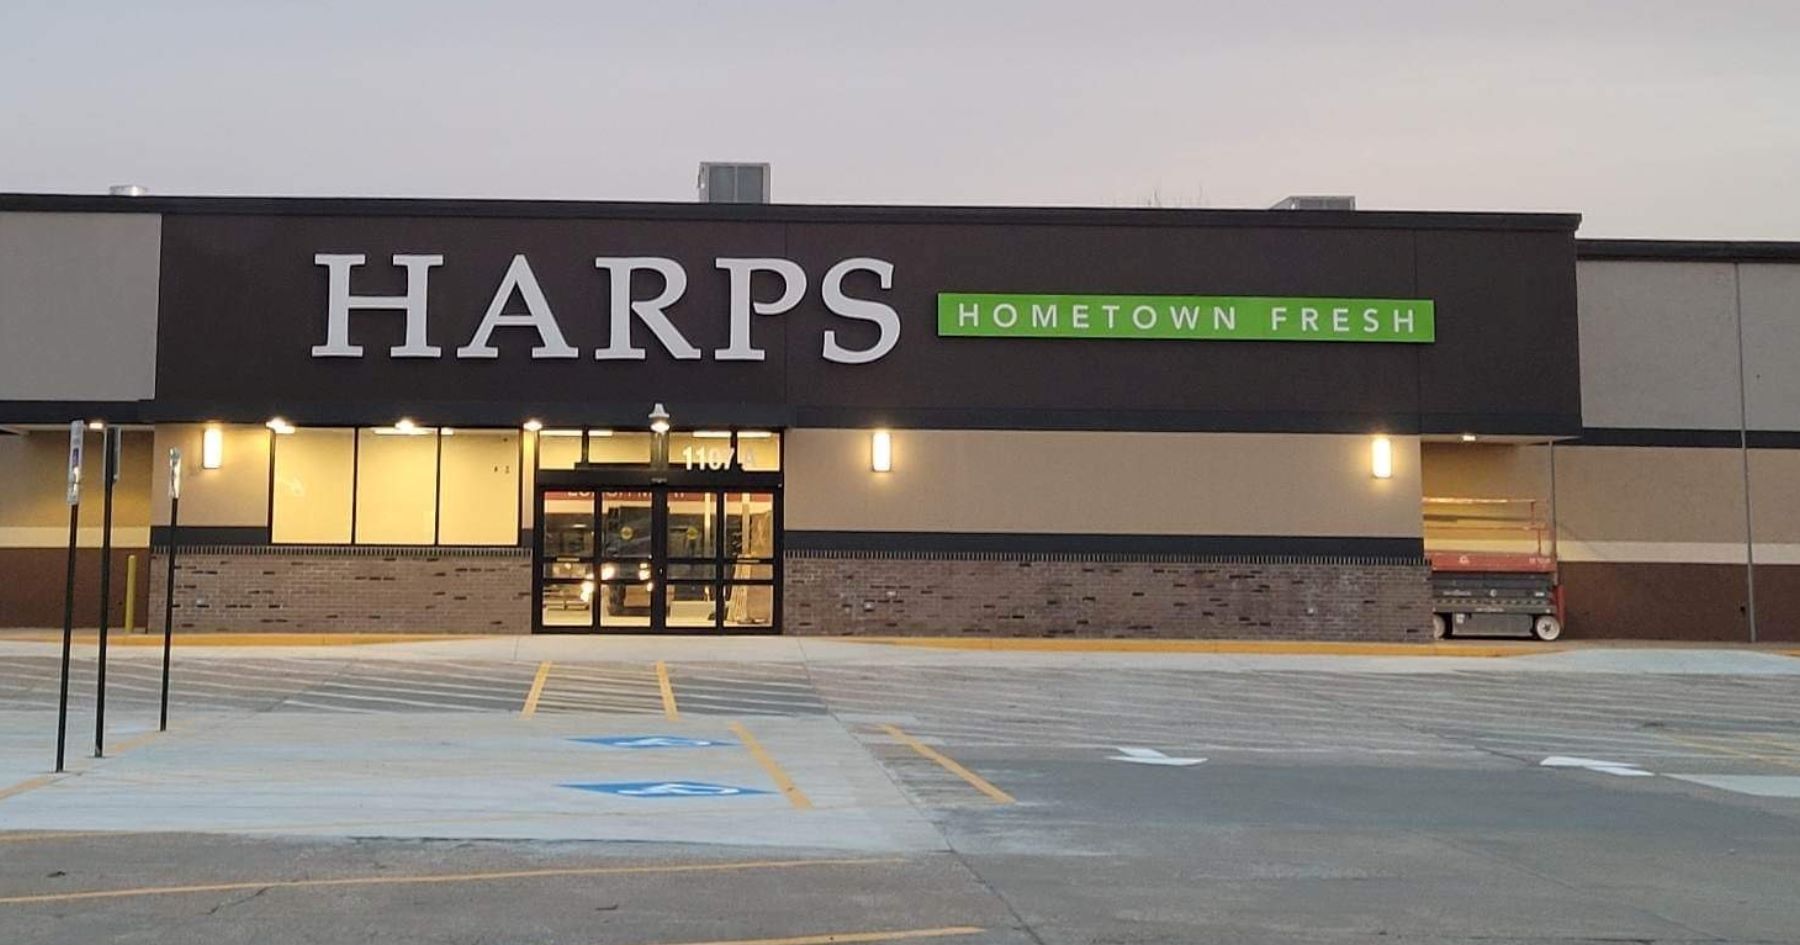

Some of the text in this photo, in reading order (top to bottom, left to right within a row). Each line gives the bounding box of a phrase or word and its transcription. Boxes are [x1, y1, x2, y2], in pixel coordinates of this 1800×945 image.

[311, 253, 901, 364] HARPS
[958, 303, 1414, 333] HOMETOWN FRESH
[682, 446, 736, 470] 1107
